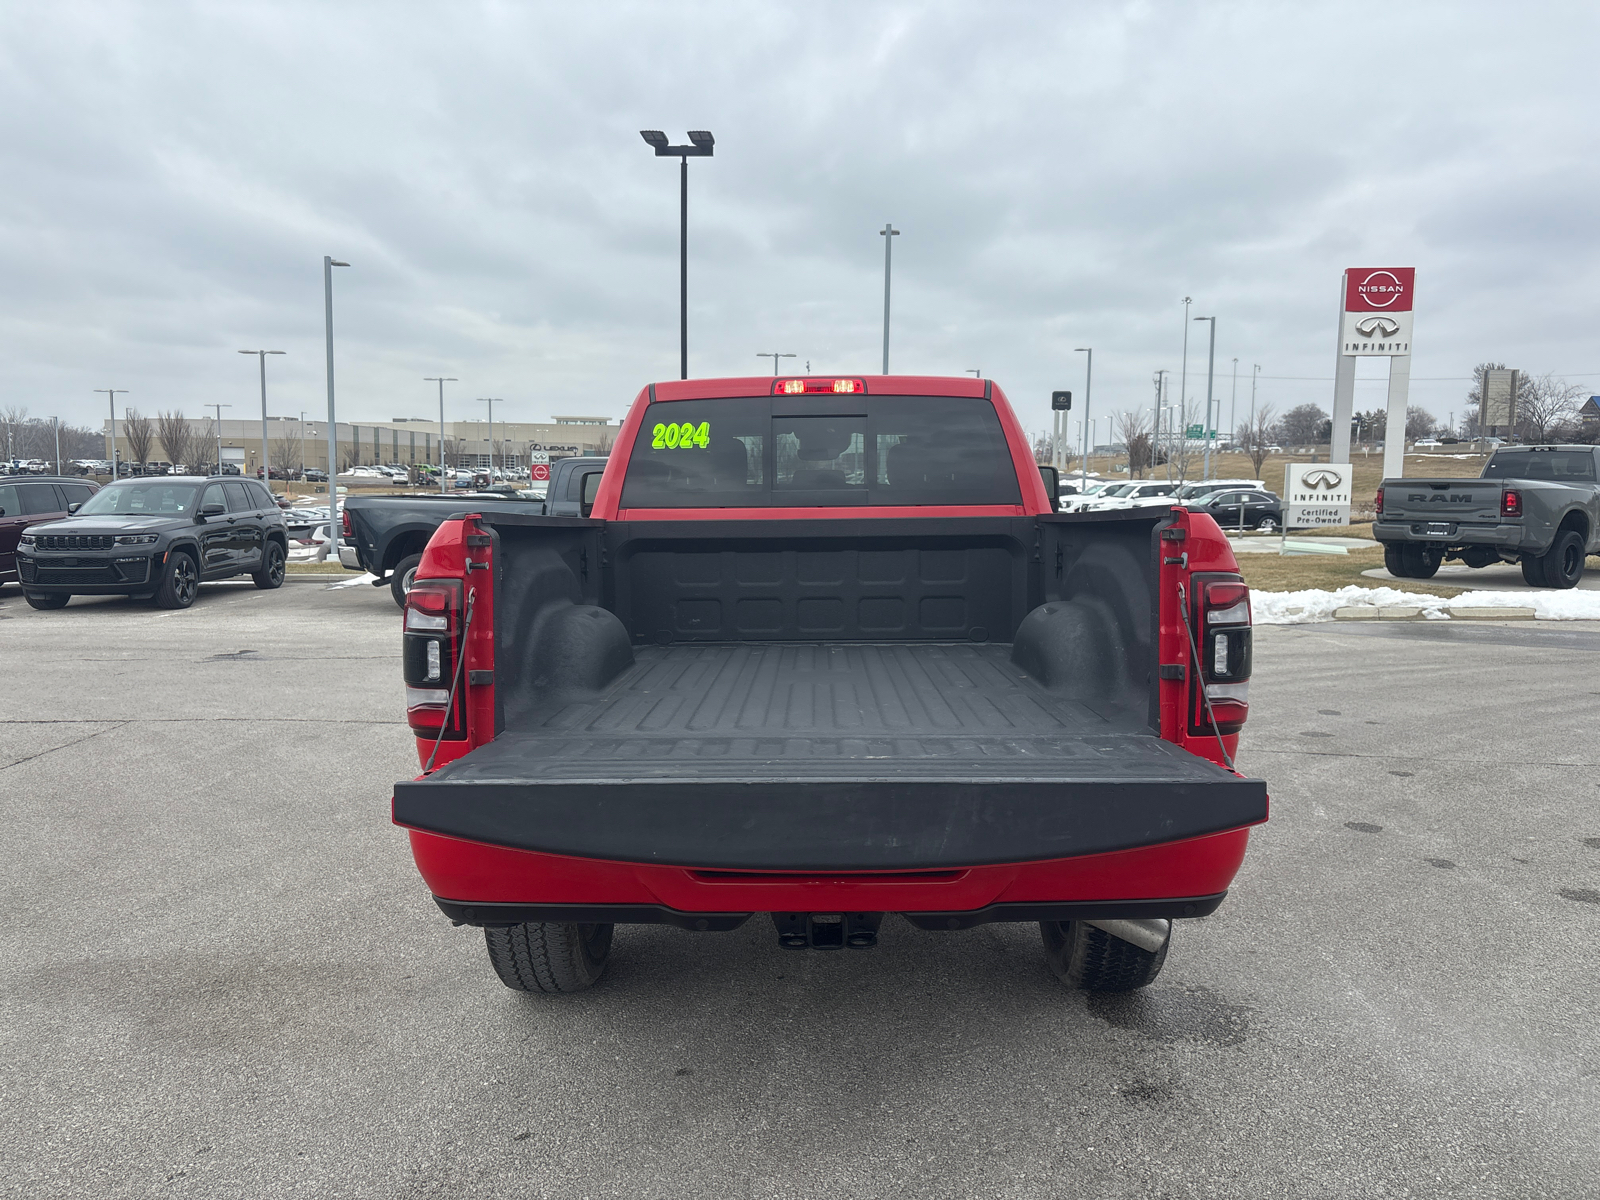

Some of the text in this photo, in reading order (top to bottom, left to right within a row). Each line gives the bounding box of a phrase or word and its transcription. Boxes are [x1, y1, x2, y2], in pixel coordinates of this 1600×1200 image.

[1358, 285, 1404, 293] NISSAN
[1345, 343, 1408, 351] INFINITI
[651, 421, 710, 450] 2024
[1294, 494, 1347, 502] INFINITI
[1407, 494, 1473, 503] RAM
